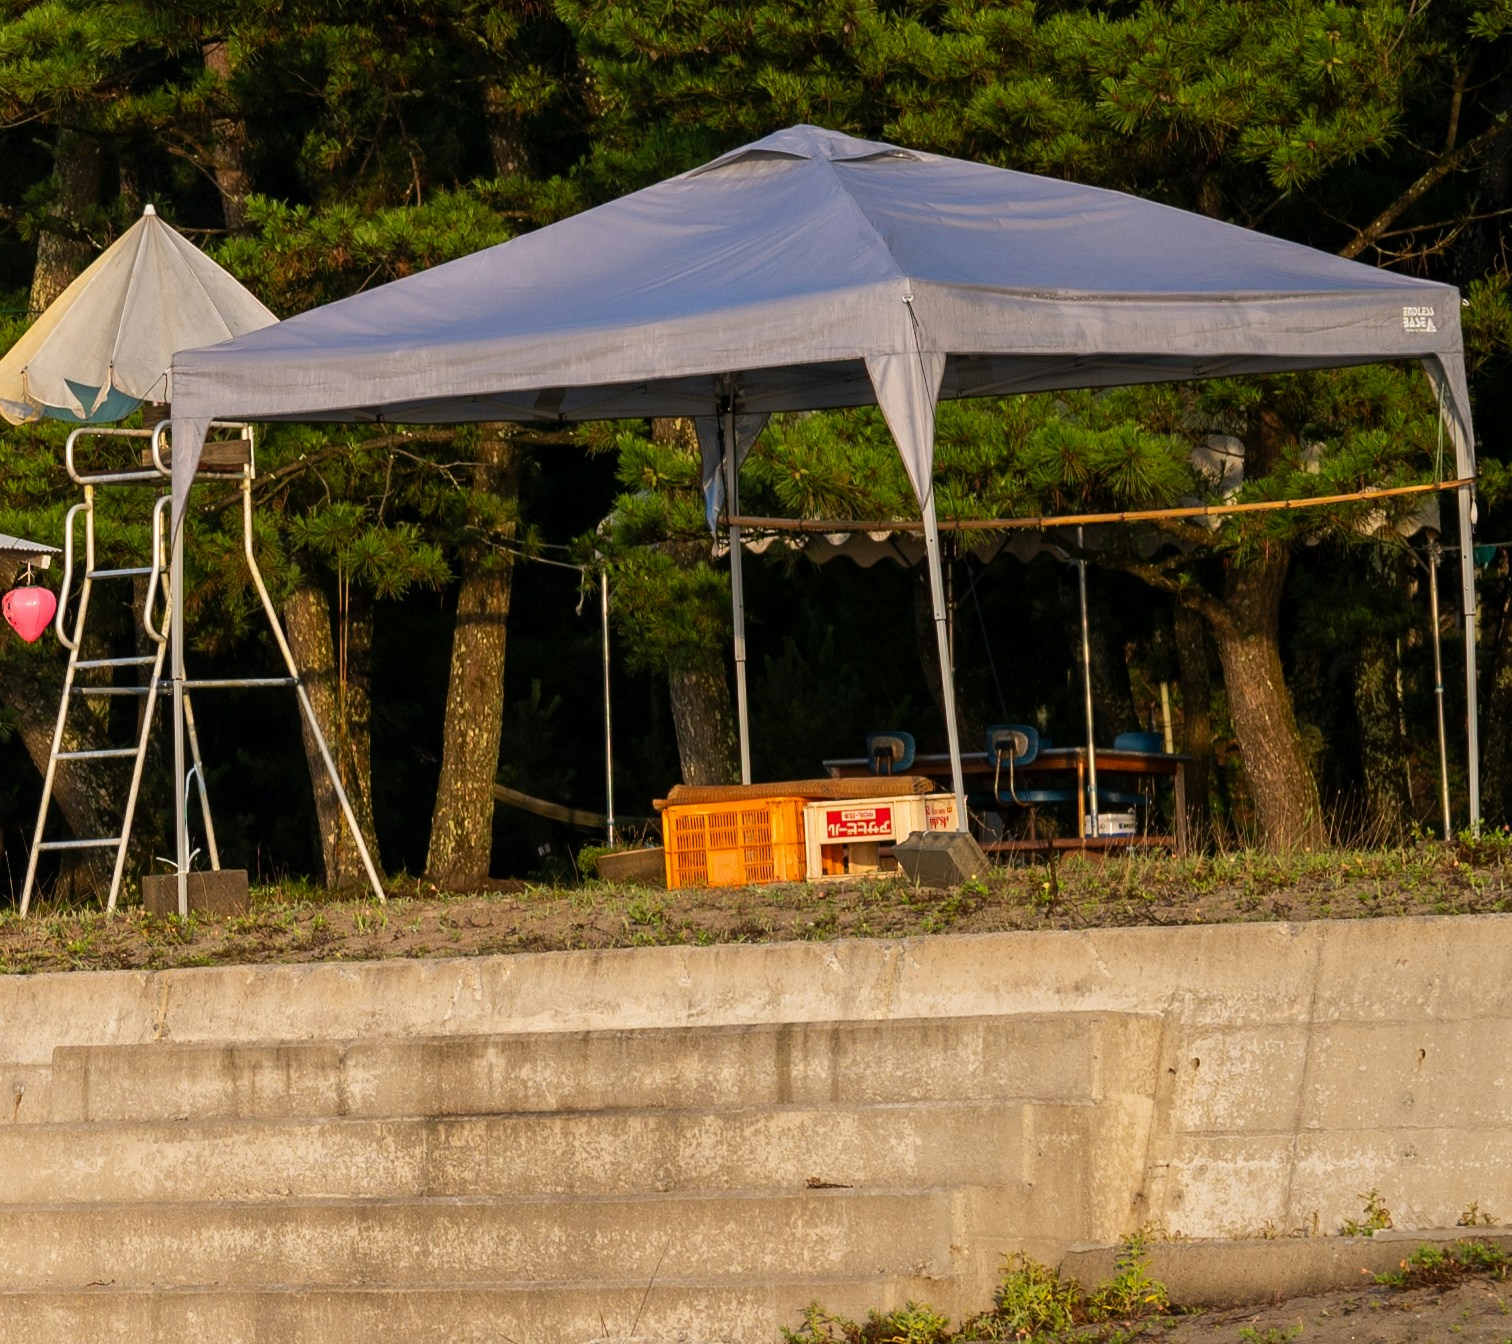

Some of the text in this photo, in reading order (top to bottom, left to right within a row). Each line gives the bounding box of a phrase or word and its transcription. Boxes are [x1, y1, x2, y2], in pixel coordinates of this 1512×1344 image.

[1403, 316, 1427, 328] BASE
[827, 820, 892, 837] アサヒビール
